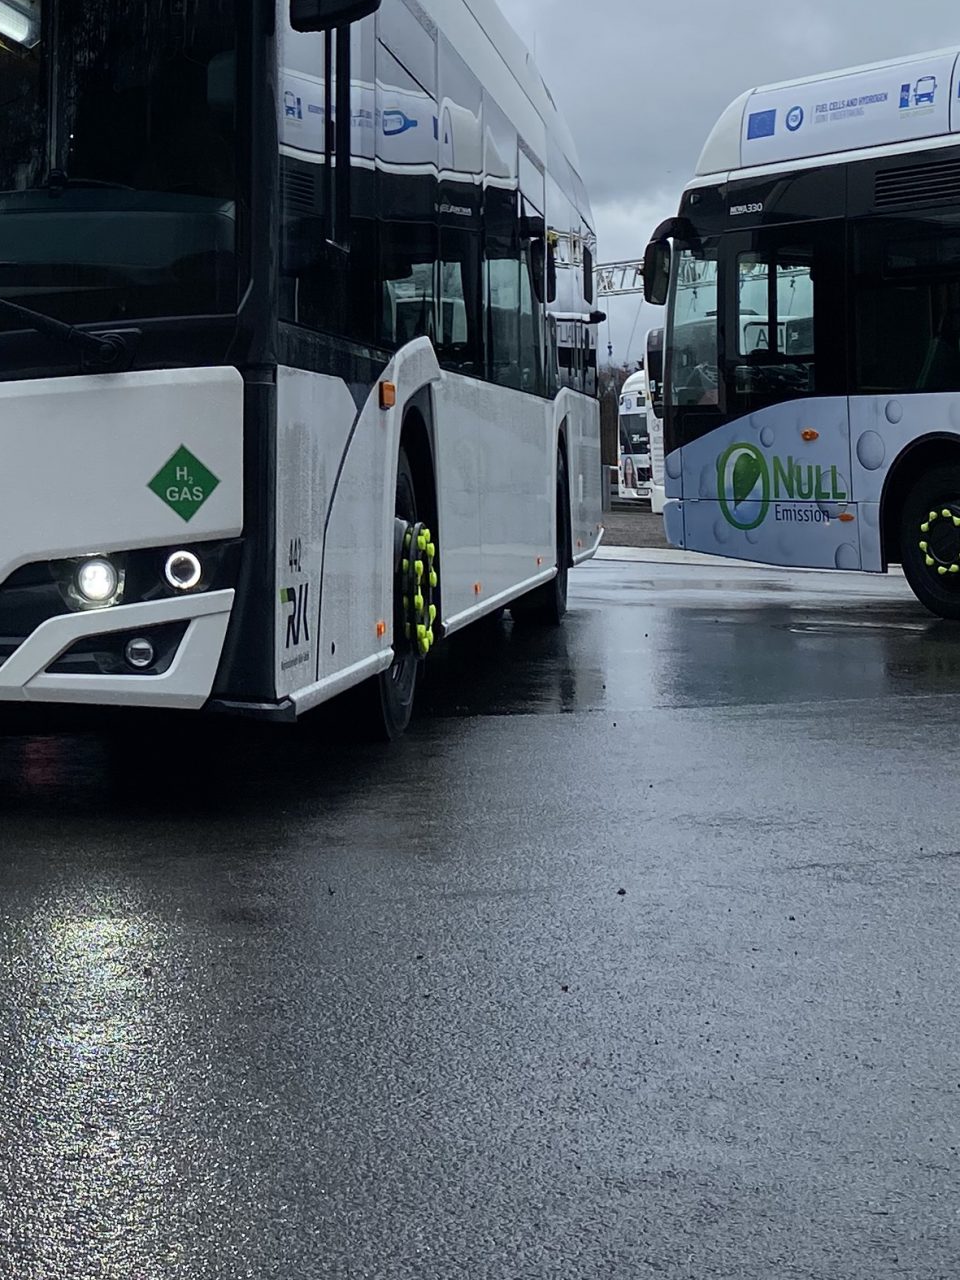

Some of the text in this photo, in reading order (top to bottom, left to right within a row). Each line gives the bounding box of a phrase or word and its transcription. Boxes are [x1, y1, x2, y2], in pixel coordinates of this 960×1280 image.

[815, 103, 828, 113] FUEL
[829, 99, 846, 111] CELLS
[846, 97, 858, 108] AND
[166, 486, 204, 501] GAS
[775, 504, 830, 522] Emission
